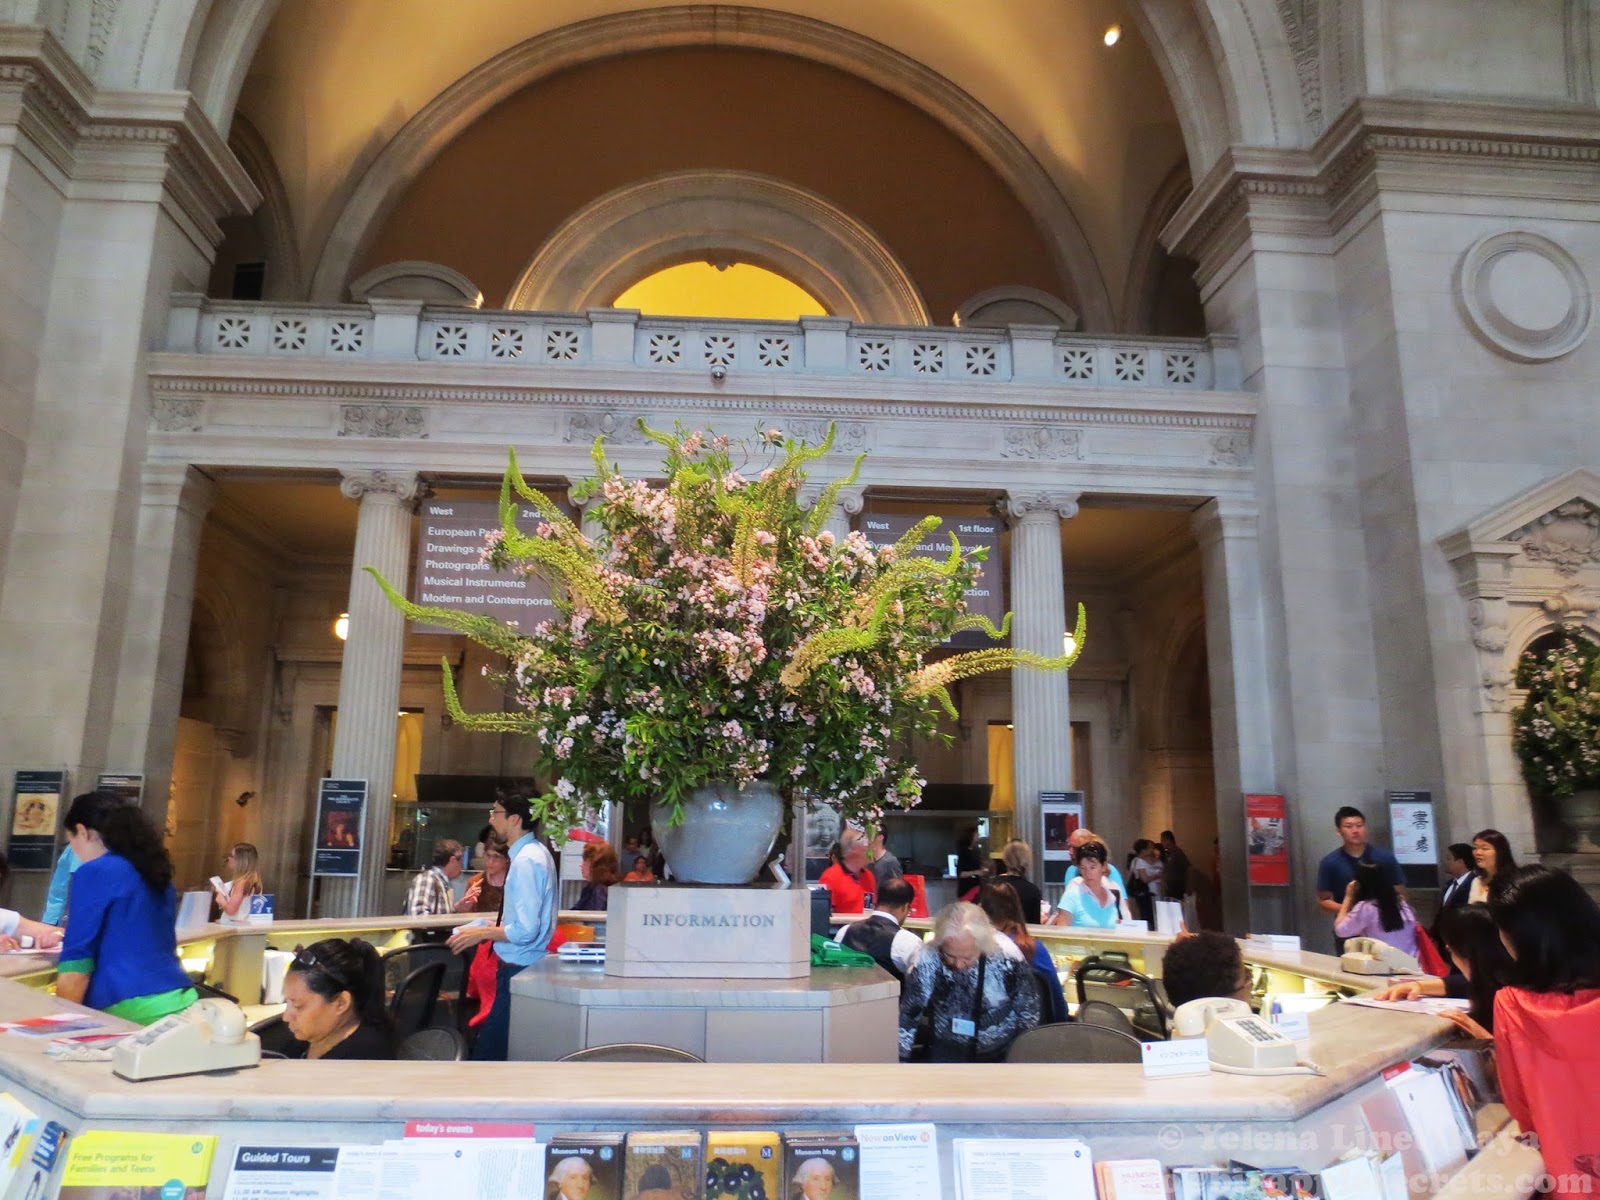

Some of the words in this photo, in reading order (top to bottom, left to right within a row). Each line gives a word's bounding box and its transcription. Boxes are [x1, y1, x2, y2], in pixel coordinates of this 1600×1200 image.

[429, 506, 453, 516] West
[522, 509, 540, 519] 2nd
[867, 521, 889, 530] West
[959, 524, 972, 533] 1st
[973, 524, 995, 533] floor
[427, 527, 476, 538] European
[426, 543, 474, 555] Drawings
[915, 542, 933, 551] and
[424, 560, 490, 571] Photographs
[423, 575, 463, 587] Musical
[465, 577, 527, 588] Instruments
[422, 593, 463, 604] Modern
[465, 594, 485, 605] and
[486, 595, 553, 607] Contemporar
[642, 913, 776, 928] INFORMATION
[415, 1123, 445, 1135] today's
[446, 1124, 474, 1134] events
[860, 1133, 882, 1143] Now
[883, 1134, 894, 1142] on
[895, 1133, 918, 1142] View
[73, 1153, 93, 1162] Free
[94, 1154, 139, 1163] Programs
[241, 1152, 279, 1163] Guided
[281, 1152, 311, 1164] Tours
[129, 1165, 156, 1173] Teens
